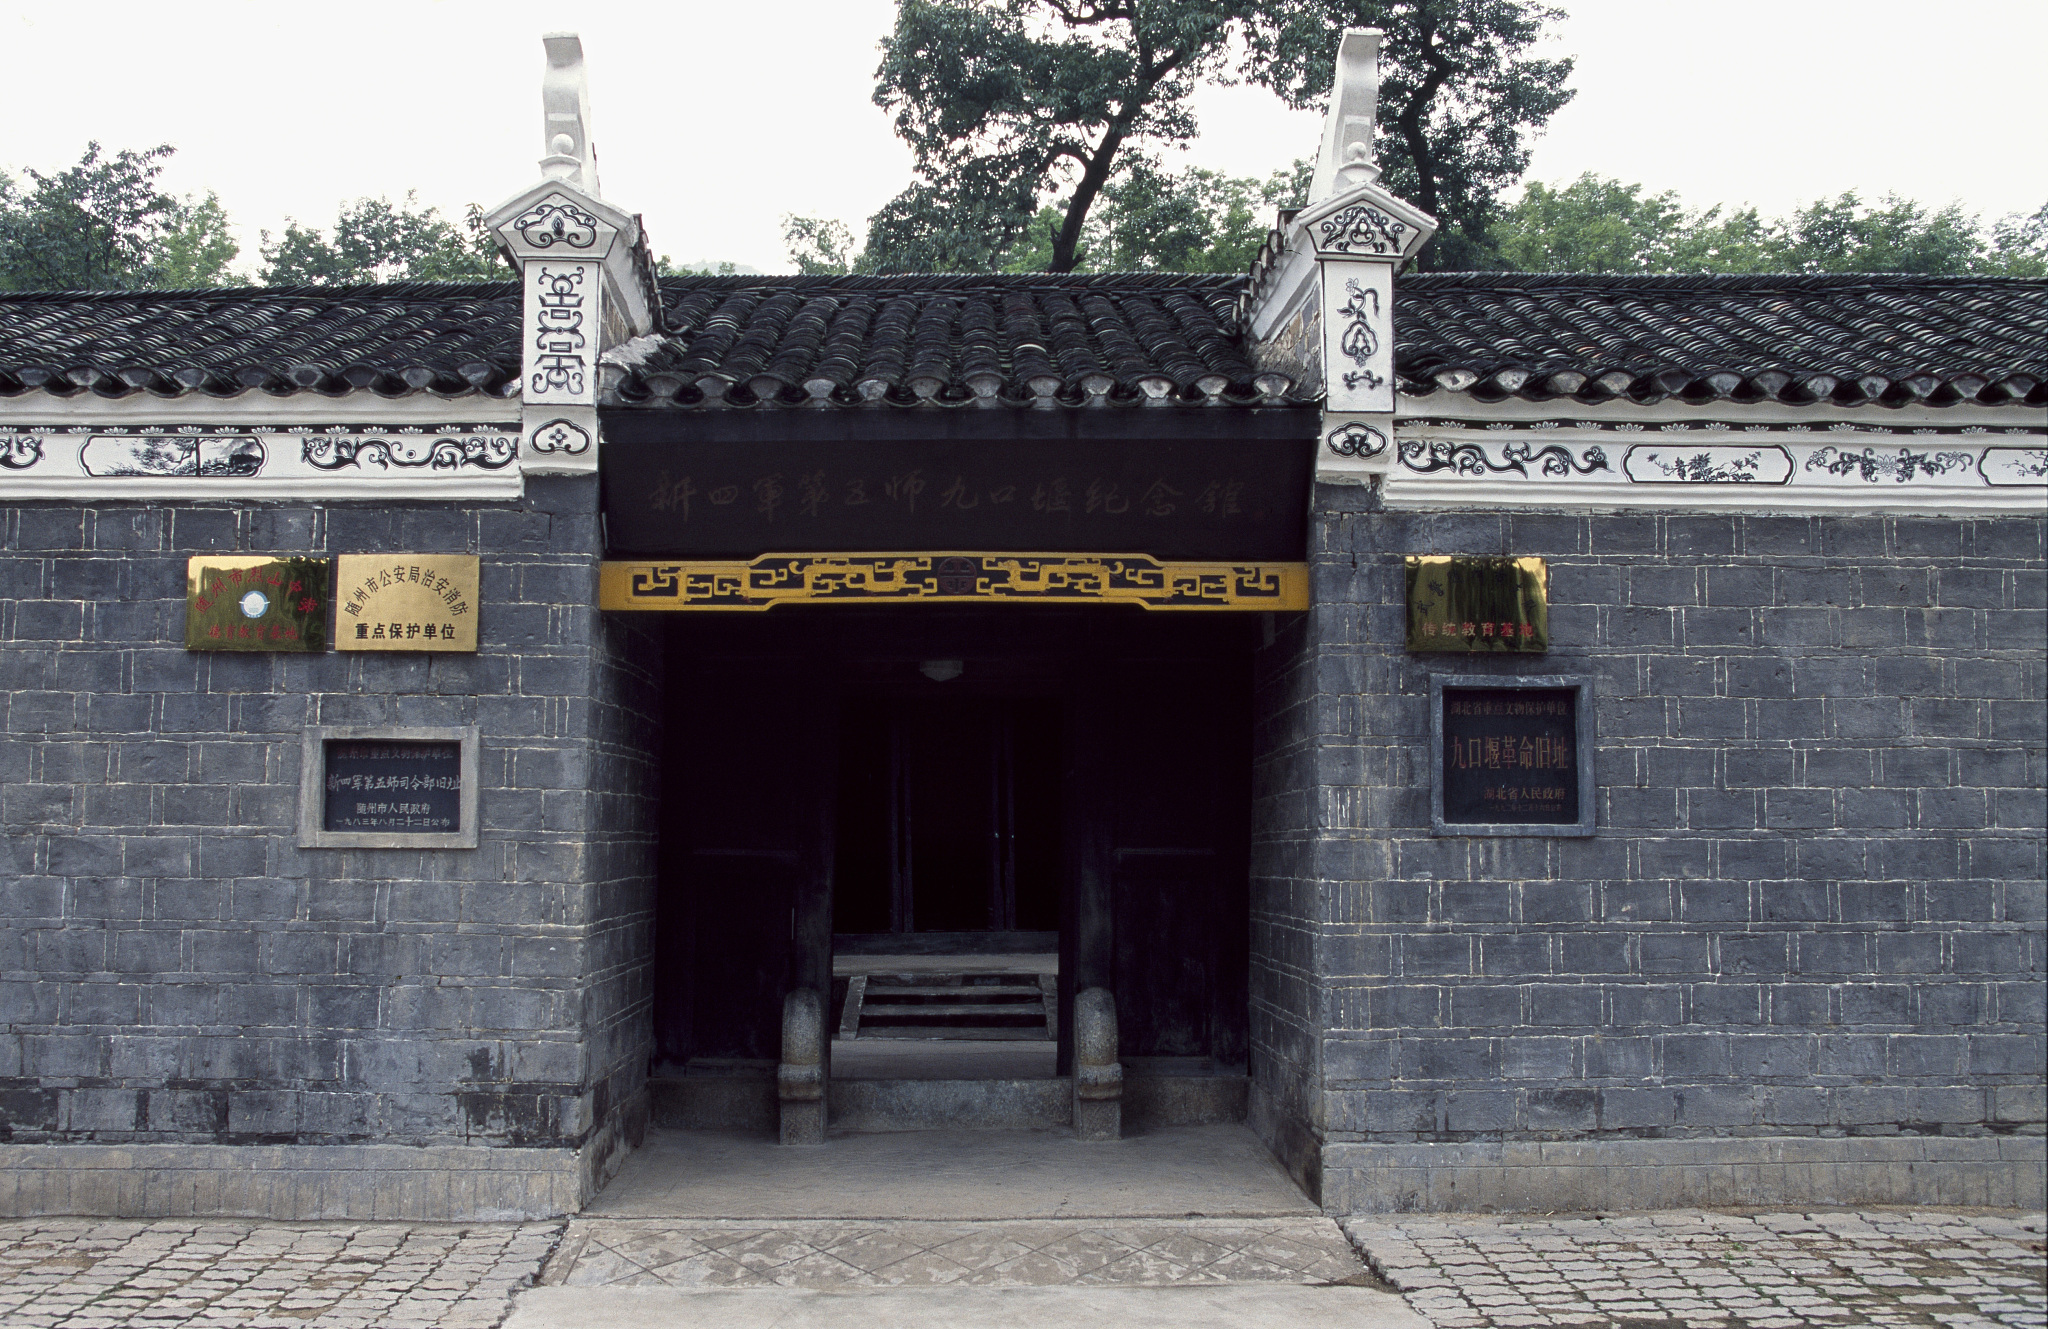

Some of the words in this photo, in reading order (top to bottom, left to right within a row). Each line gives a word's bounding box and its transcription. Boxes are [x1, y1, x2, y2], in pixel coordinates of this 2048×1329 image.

[344, 565, 469, 617] 随州市公安局治安消防
[209, 624, 299, 640] 德育教育基地
[355, 623, 455, 640] 重点保护单位
[1422, 622, 1534, 637] 传统教育基地
[1450, 736, 1568, 770] 九口堰革命旧址
[326, 774, 461, 792] 新四军第五师司令部旧址
[1484, 787, 1566, 801] 湖北省人民政府
[356, 803, 431, 815] 随州市人民政府
[335, 816, 451, 827] 一九八三年八月二十二日公布
